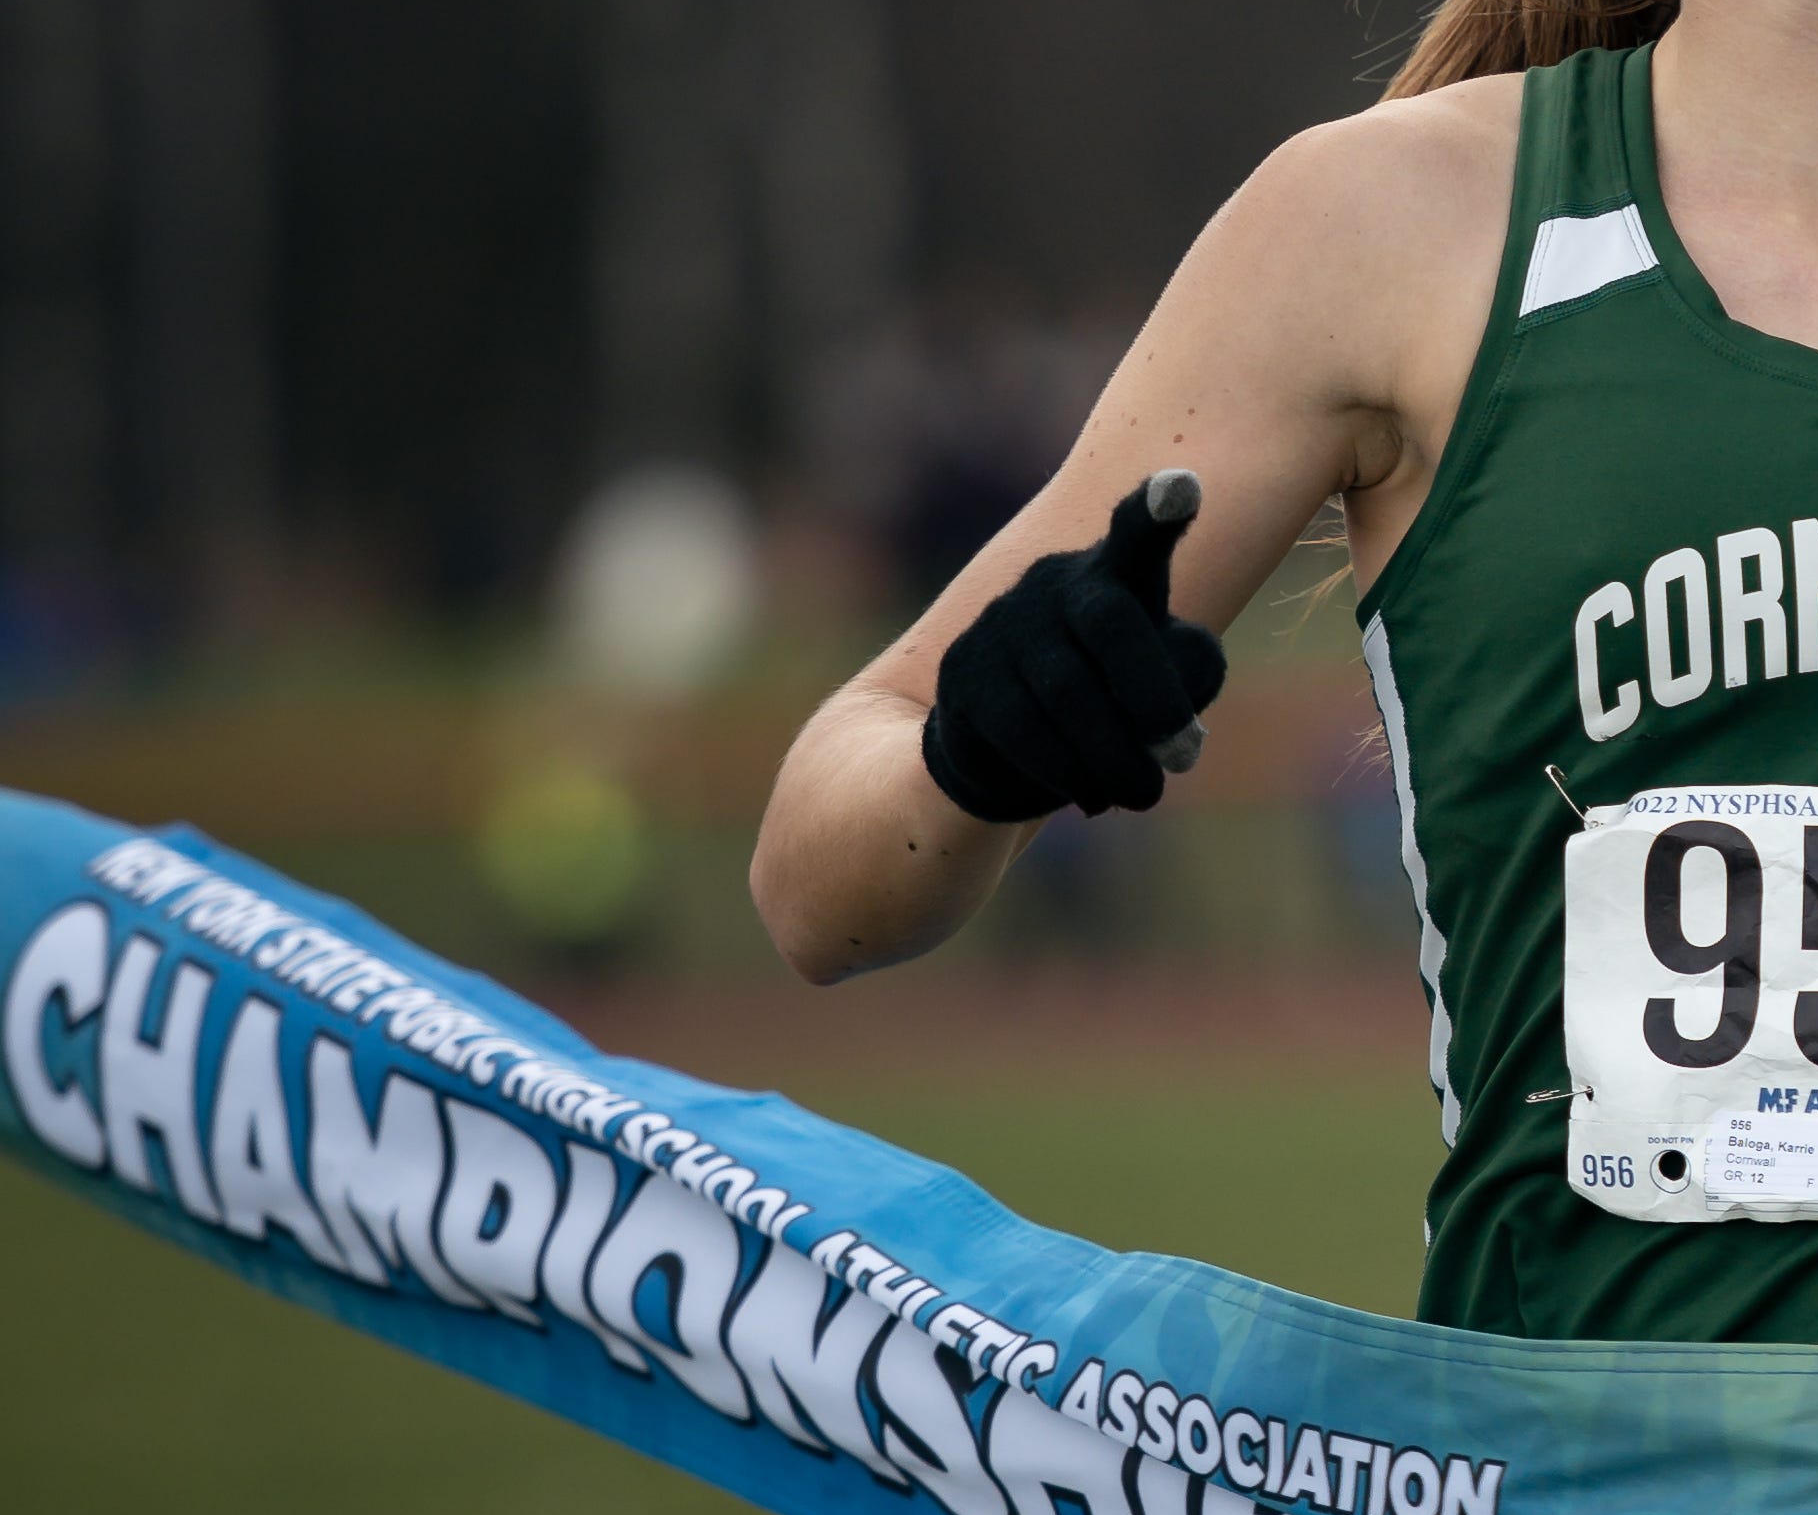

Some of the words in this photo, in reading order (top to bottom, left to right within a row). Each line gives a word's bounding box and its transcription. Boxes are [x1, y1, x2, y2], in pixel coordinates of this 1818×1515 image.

[254, 926, 413, 1013] STATE
[358, 985, 540, 1086] PUBLIC
[501, 1058, 646, 1140] HIGH
[1730, 1119, 1752, 1131] 956
[1728, 1136, 1774, 1152] Baloga,
[1778, 1141, 1815, 1155] Karrie
[1582, 1154, 1635, 1188] 956
[1750, 1173, 1765, 1184] 12
[1806, 1178, 1815, 1188] F
